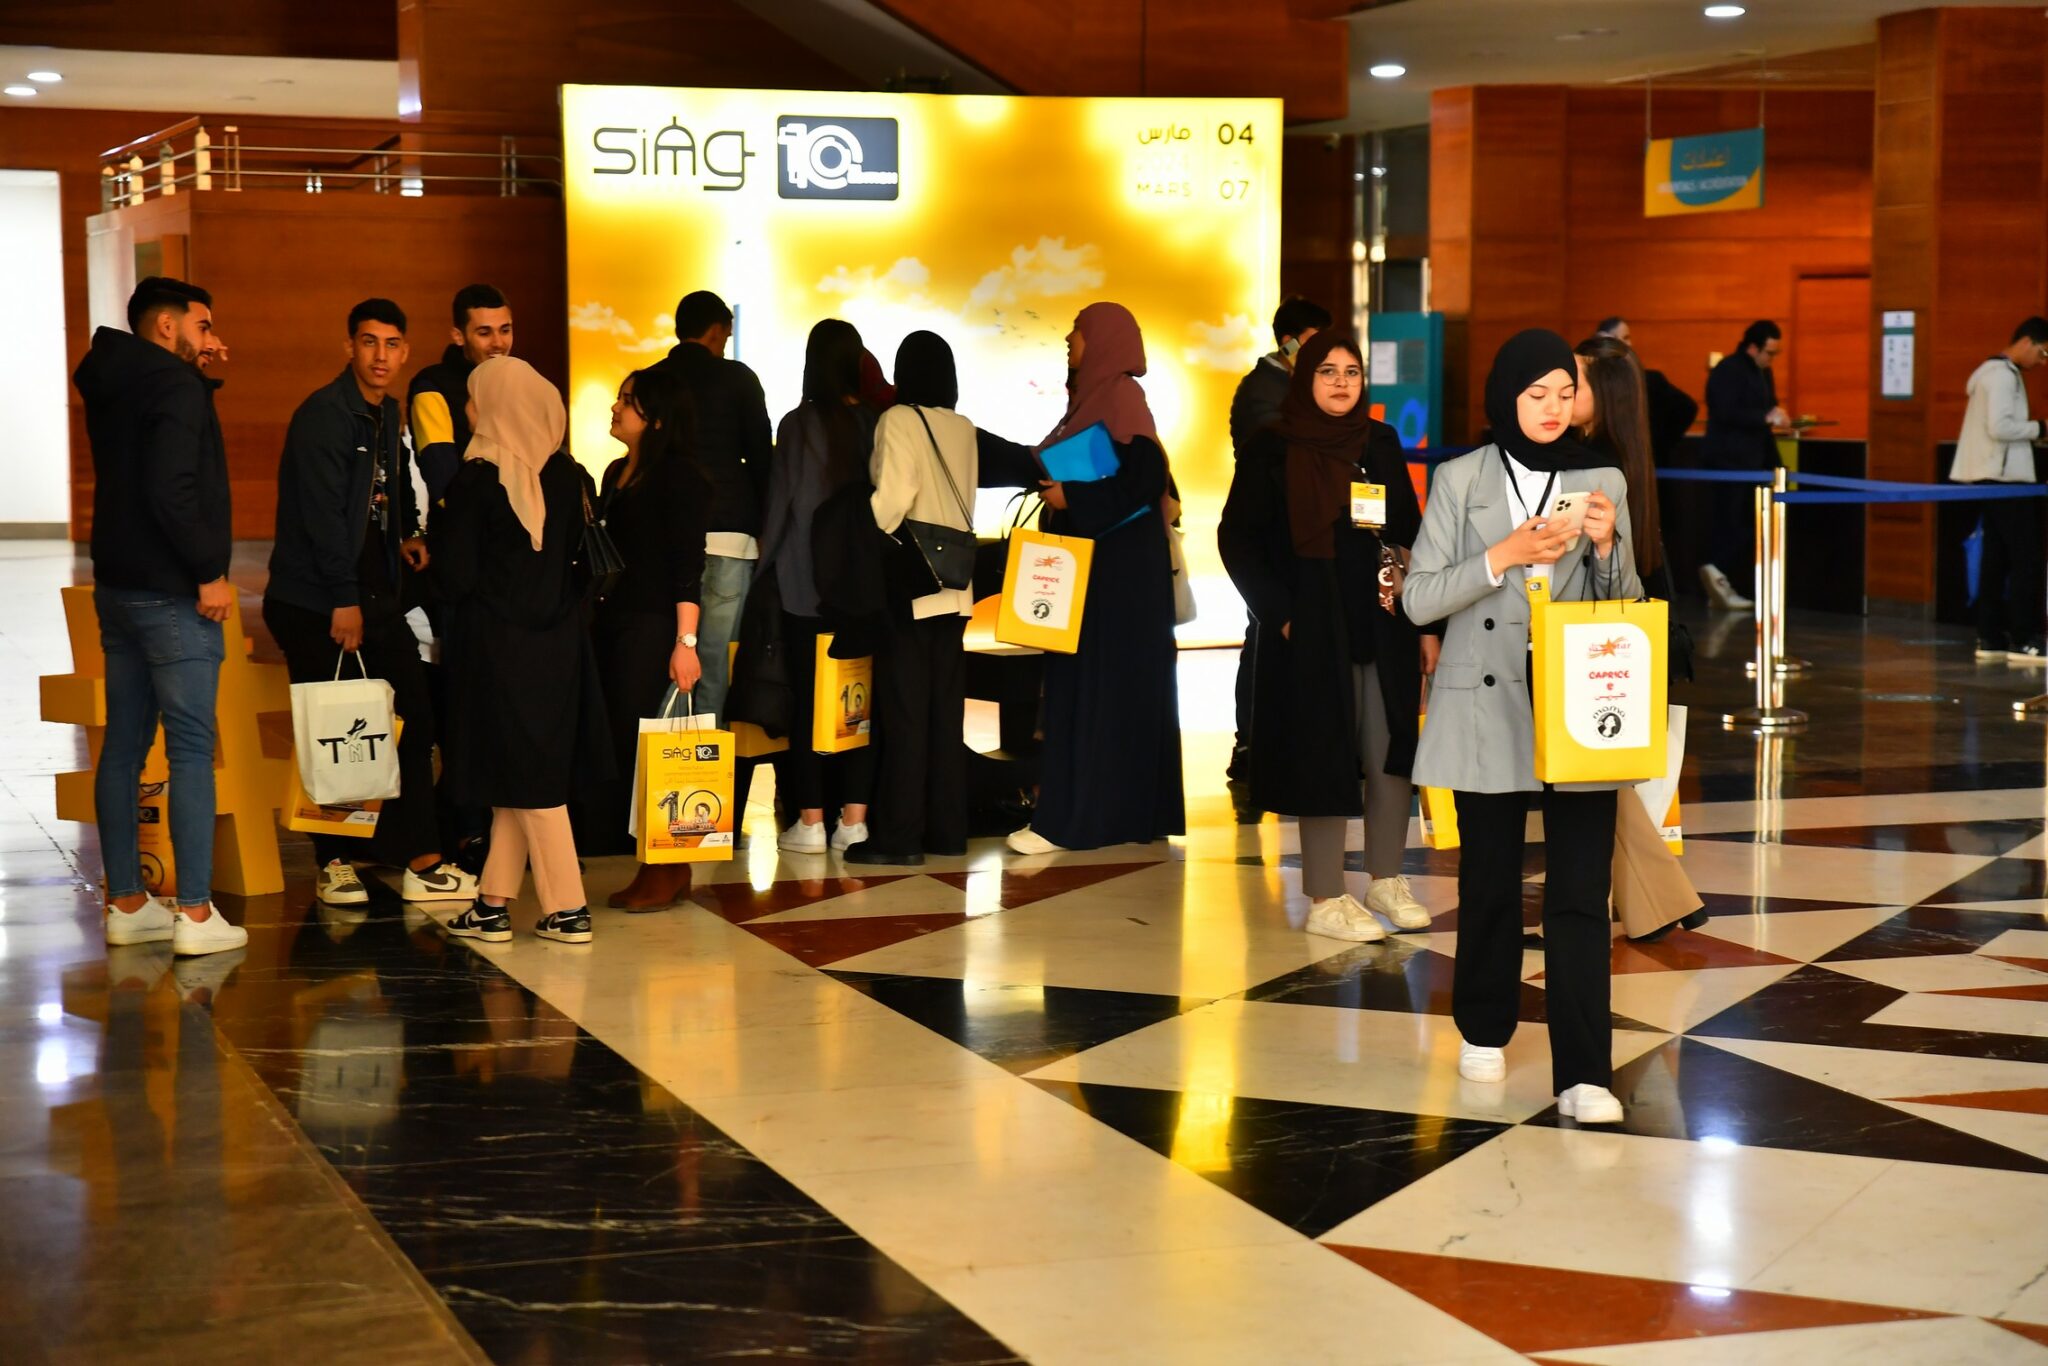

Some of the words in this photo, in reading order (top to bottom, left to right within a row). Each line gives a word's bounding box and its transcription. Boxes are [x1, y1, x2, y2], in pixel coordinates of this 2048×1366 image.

[1137, 122, 1191, 145] مارس
[1218, 122, 1254, 145] 04
[1219, 180, 1250, 200] 07
[1588, 670, 1630, 679] CAPRICE
